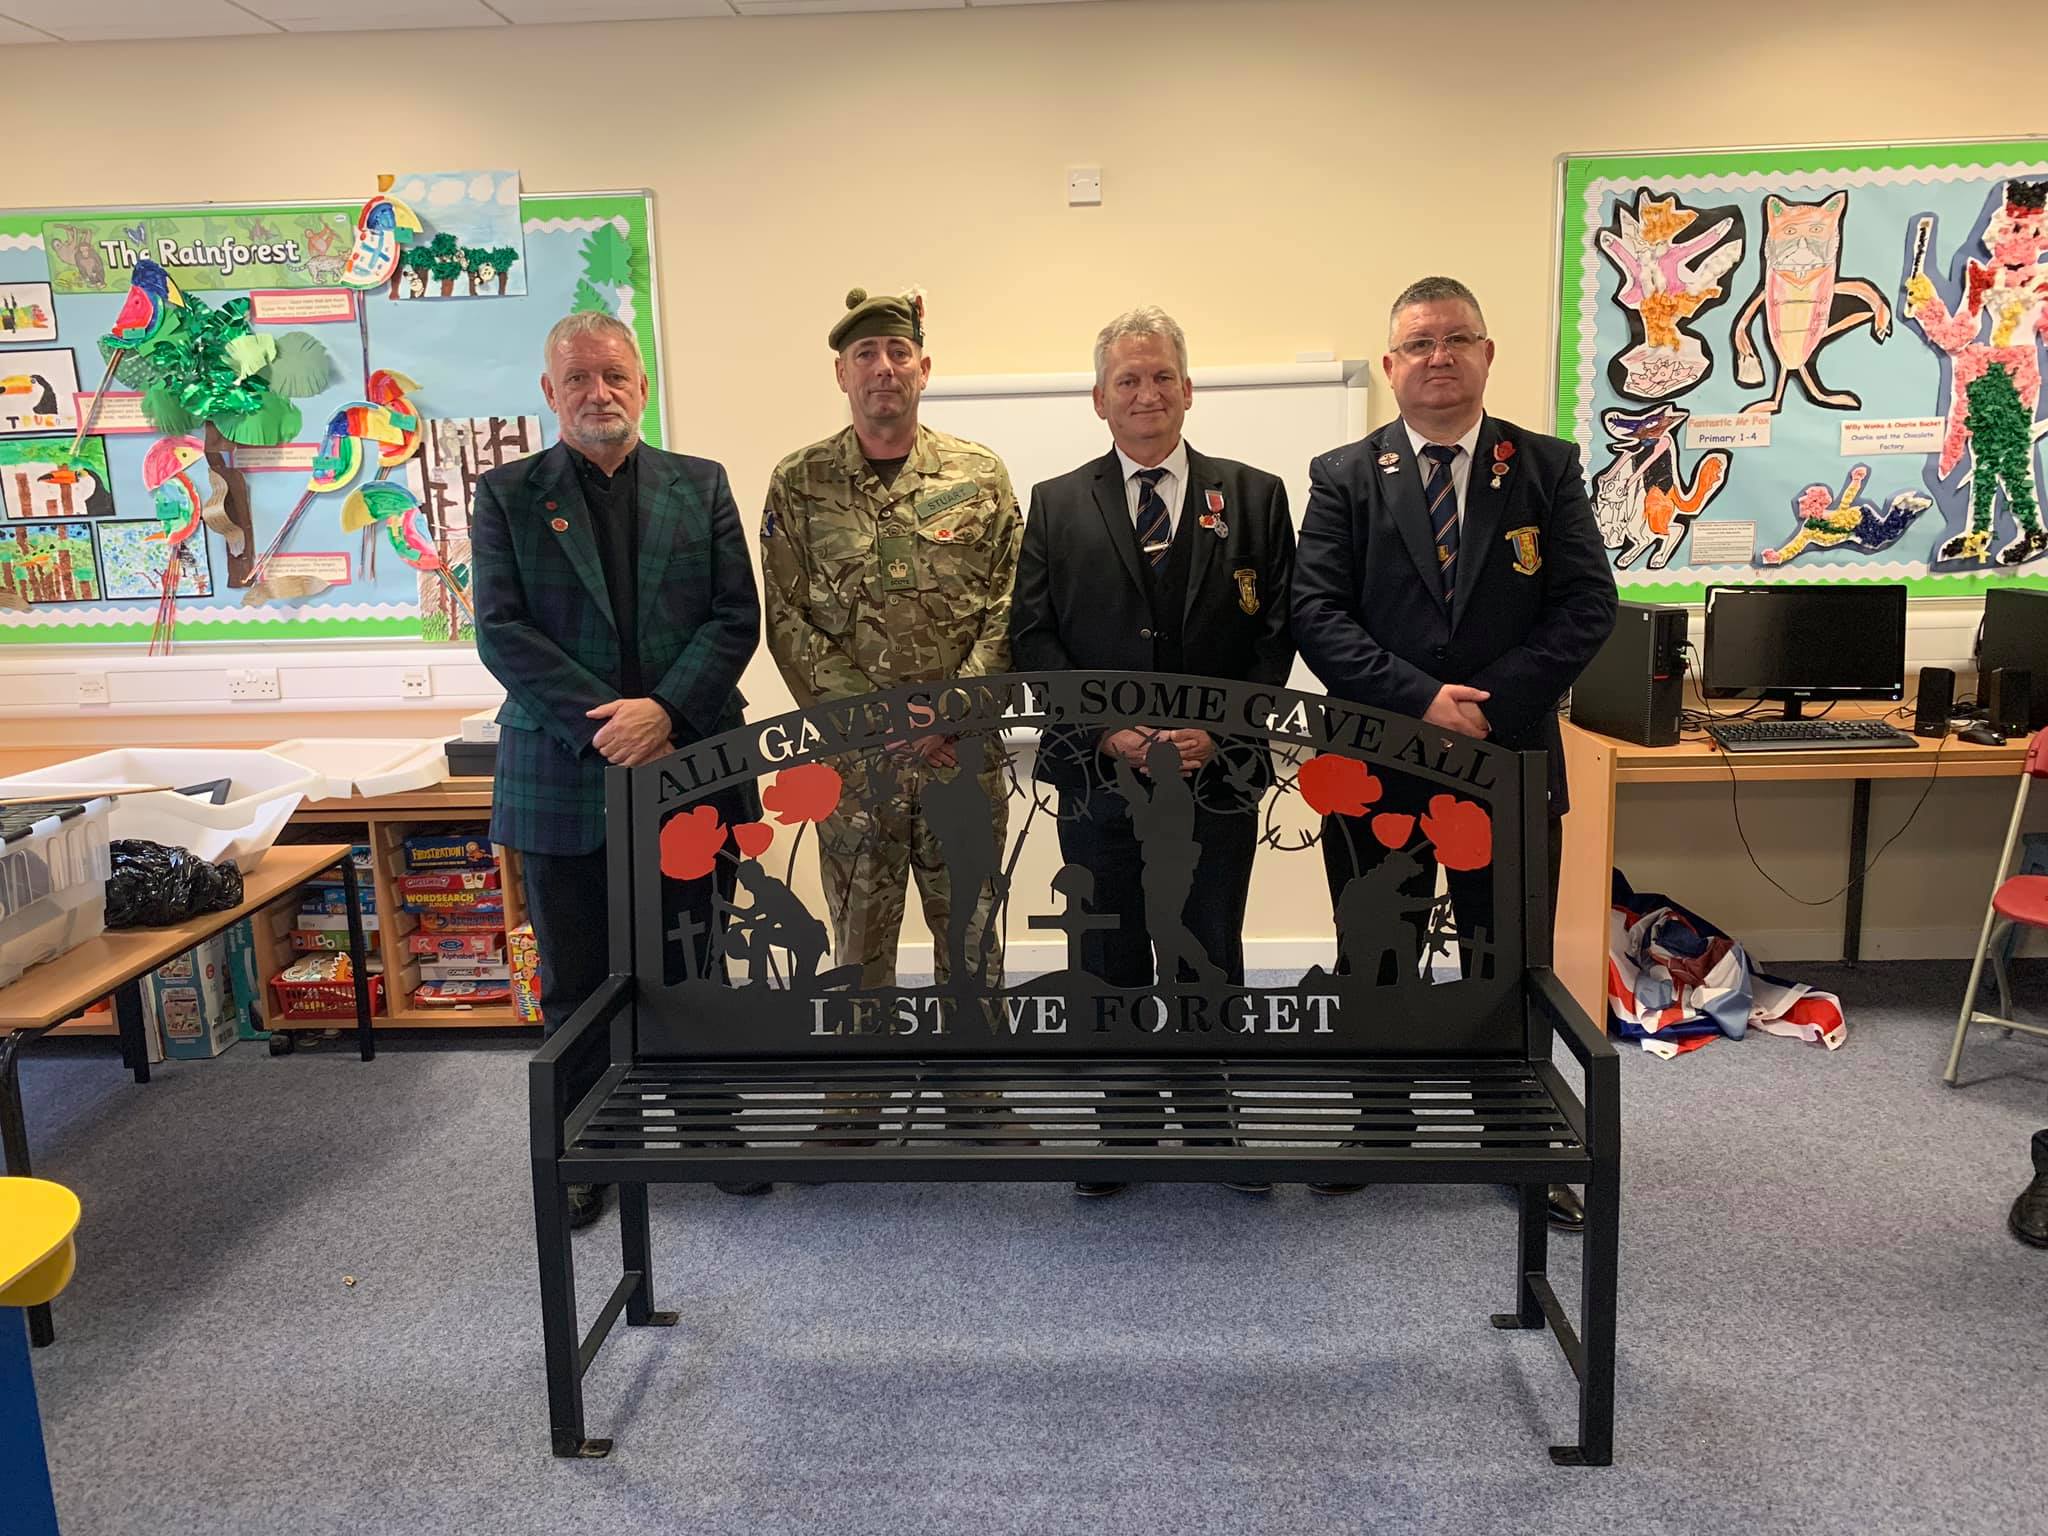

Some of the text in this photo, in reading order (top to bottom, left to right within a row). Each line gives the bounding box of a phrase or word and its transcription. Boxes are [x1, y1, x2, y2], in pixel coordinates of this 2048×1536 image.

[157, 236, 301, 276] Rainforest
[1688, 417, 1732, 428] Fantastic
[1699, 433, 1736, 443] Primary
[1903, 431, 1934, 439] Chocolate
[927, 488, 966, 511] STUART
[657, 742, 749, 804] ALL
[758, 702, 894, 762] GAVE
[1079, 678, 1227, 723] SOME
[1243, 692, 1386, 754] GAVE
[1392, 730, 1497, 790] ALL
[406, 893, 475, 903] WORDSEARCH
[809, 994, 1341, 1036] LEST WE FORGET
